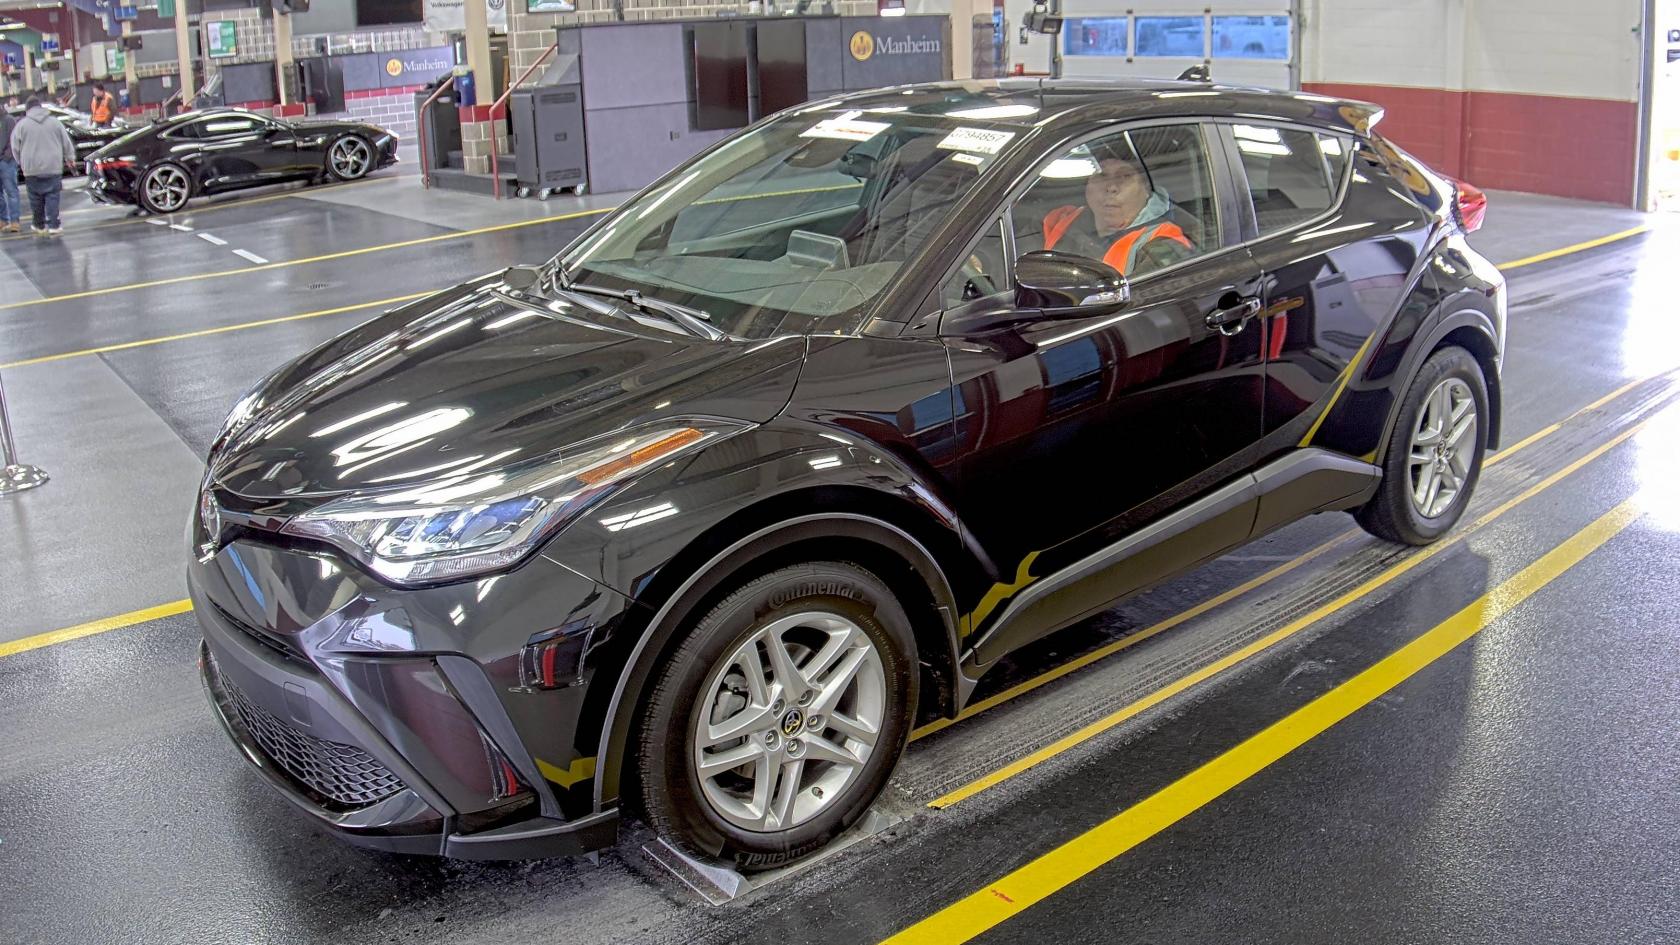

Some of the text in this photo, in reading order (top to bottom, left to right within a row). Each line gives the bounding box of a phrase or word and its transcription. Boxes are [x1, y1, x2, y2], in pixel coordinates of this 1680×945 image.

[876, 34, 941, 55] Manheim
[403, 59, 448, 73] Manheim
[767, 582, 854, 610] Continental
